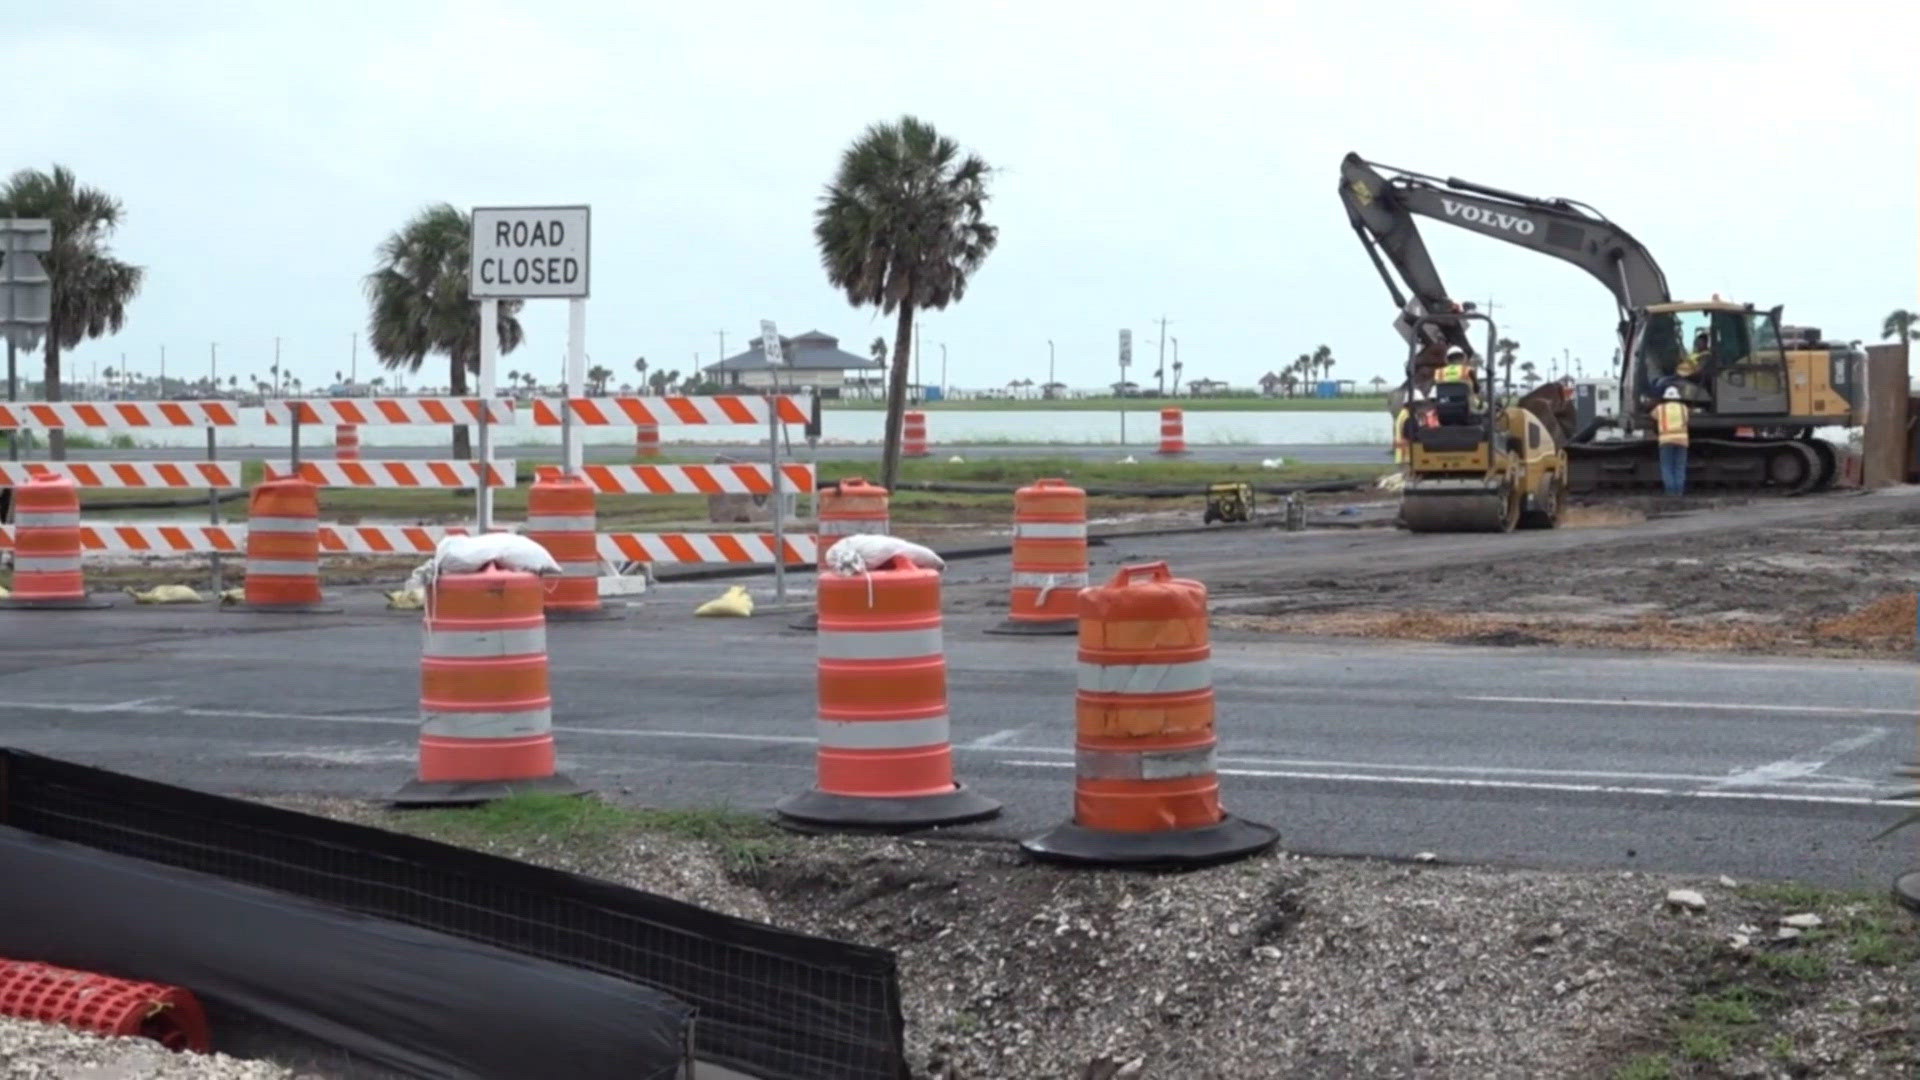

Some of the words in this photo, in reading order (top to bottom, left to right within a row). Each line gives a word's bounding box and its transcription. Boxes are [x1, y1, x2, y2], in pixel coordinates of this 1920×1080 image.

[1442, 200, 1535, 235] VOLVO
[496, 220, 564, 247] ROAD
[481, 257, 578, 285] CLOSED
